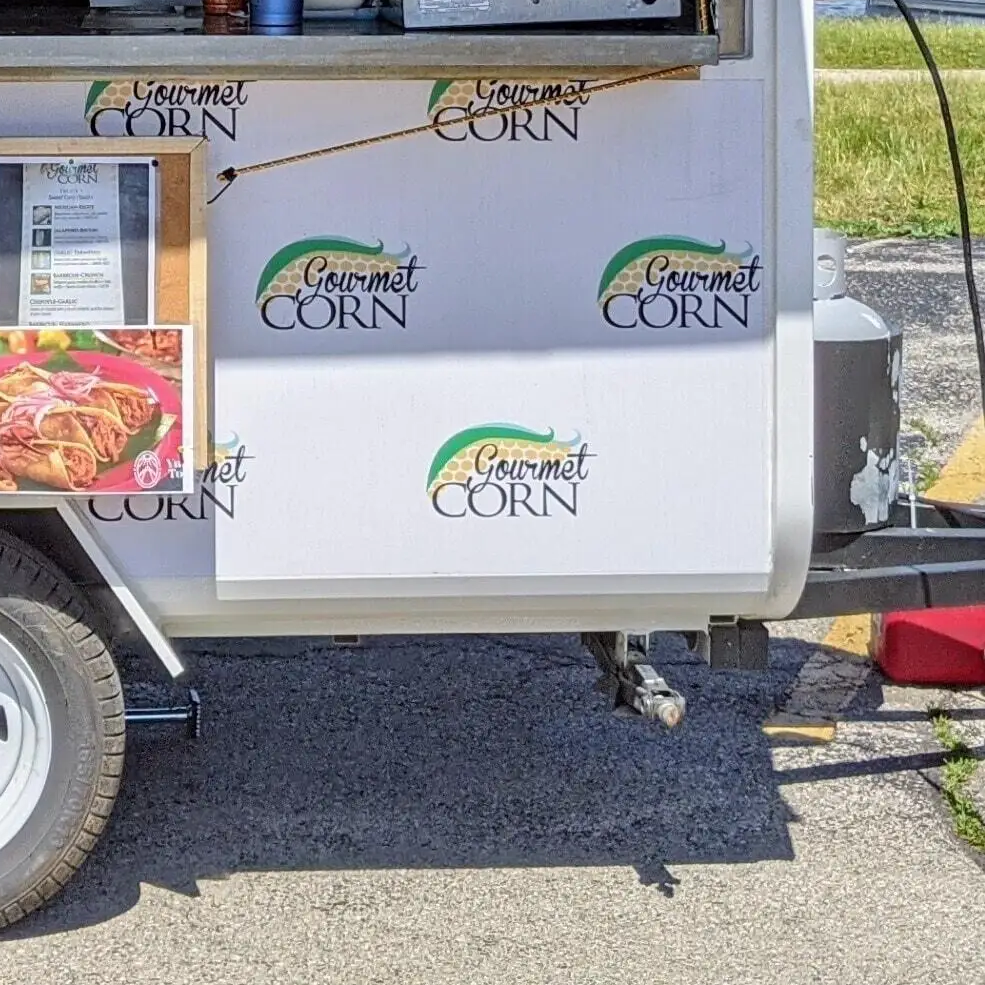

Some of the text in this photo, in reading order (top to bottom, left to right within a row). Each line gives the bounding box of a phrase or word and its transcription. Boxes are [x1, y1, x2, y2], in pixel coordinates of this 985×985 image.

[90, 107, 241, 142] CORN
[433, 107, 581, 142] CORN
[58, 175, 97, 184] CORN
[296, 255, 427, 305] Gourmet
[638, 254, 763, 304] Gourmet
[261, 294, 409, 330] CORN
[602, 293, 751, 328] CORN
[467, 443, 597, 493] Gourmet
[88, 485, 238, 522] CORN
[432, 482, 580, 518] CORN
